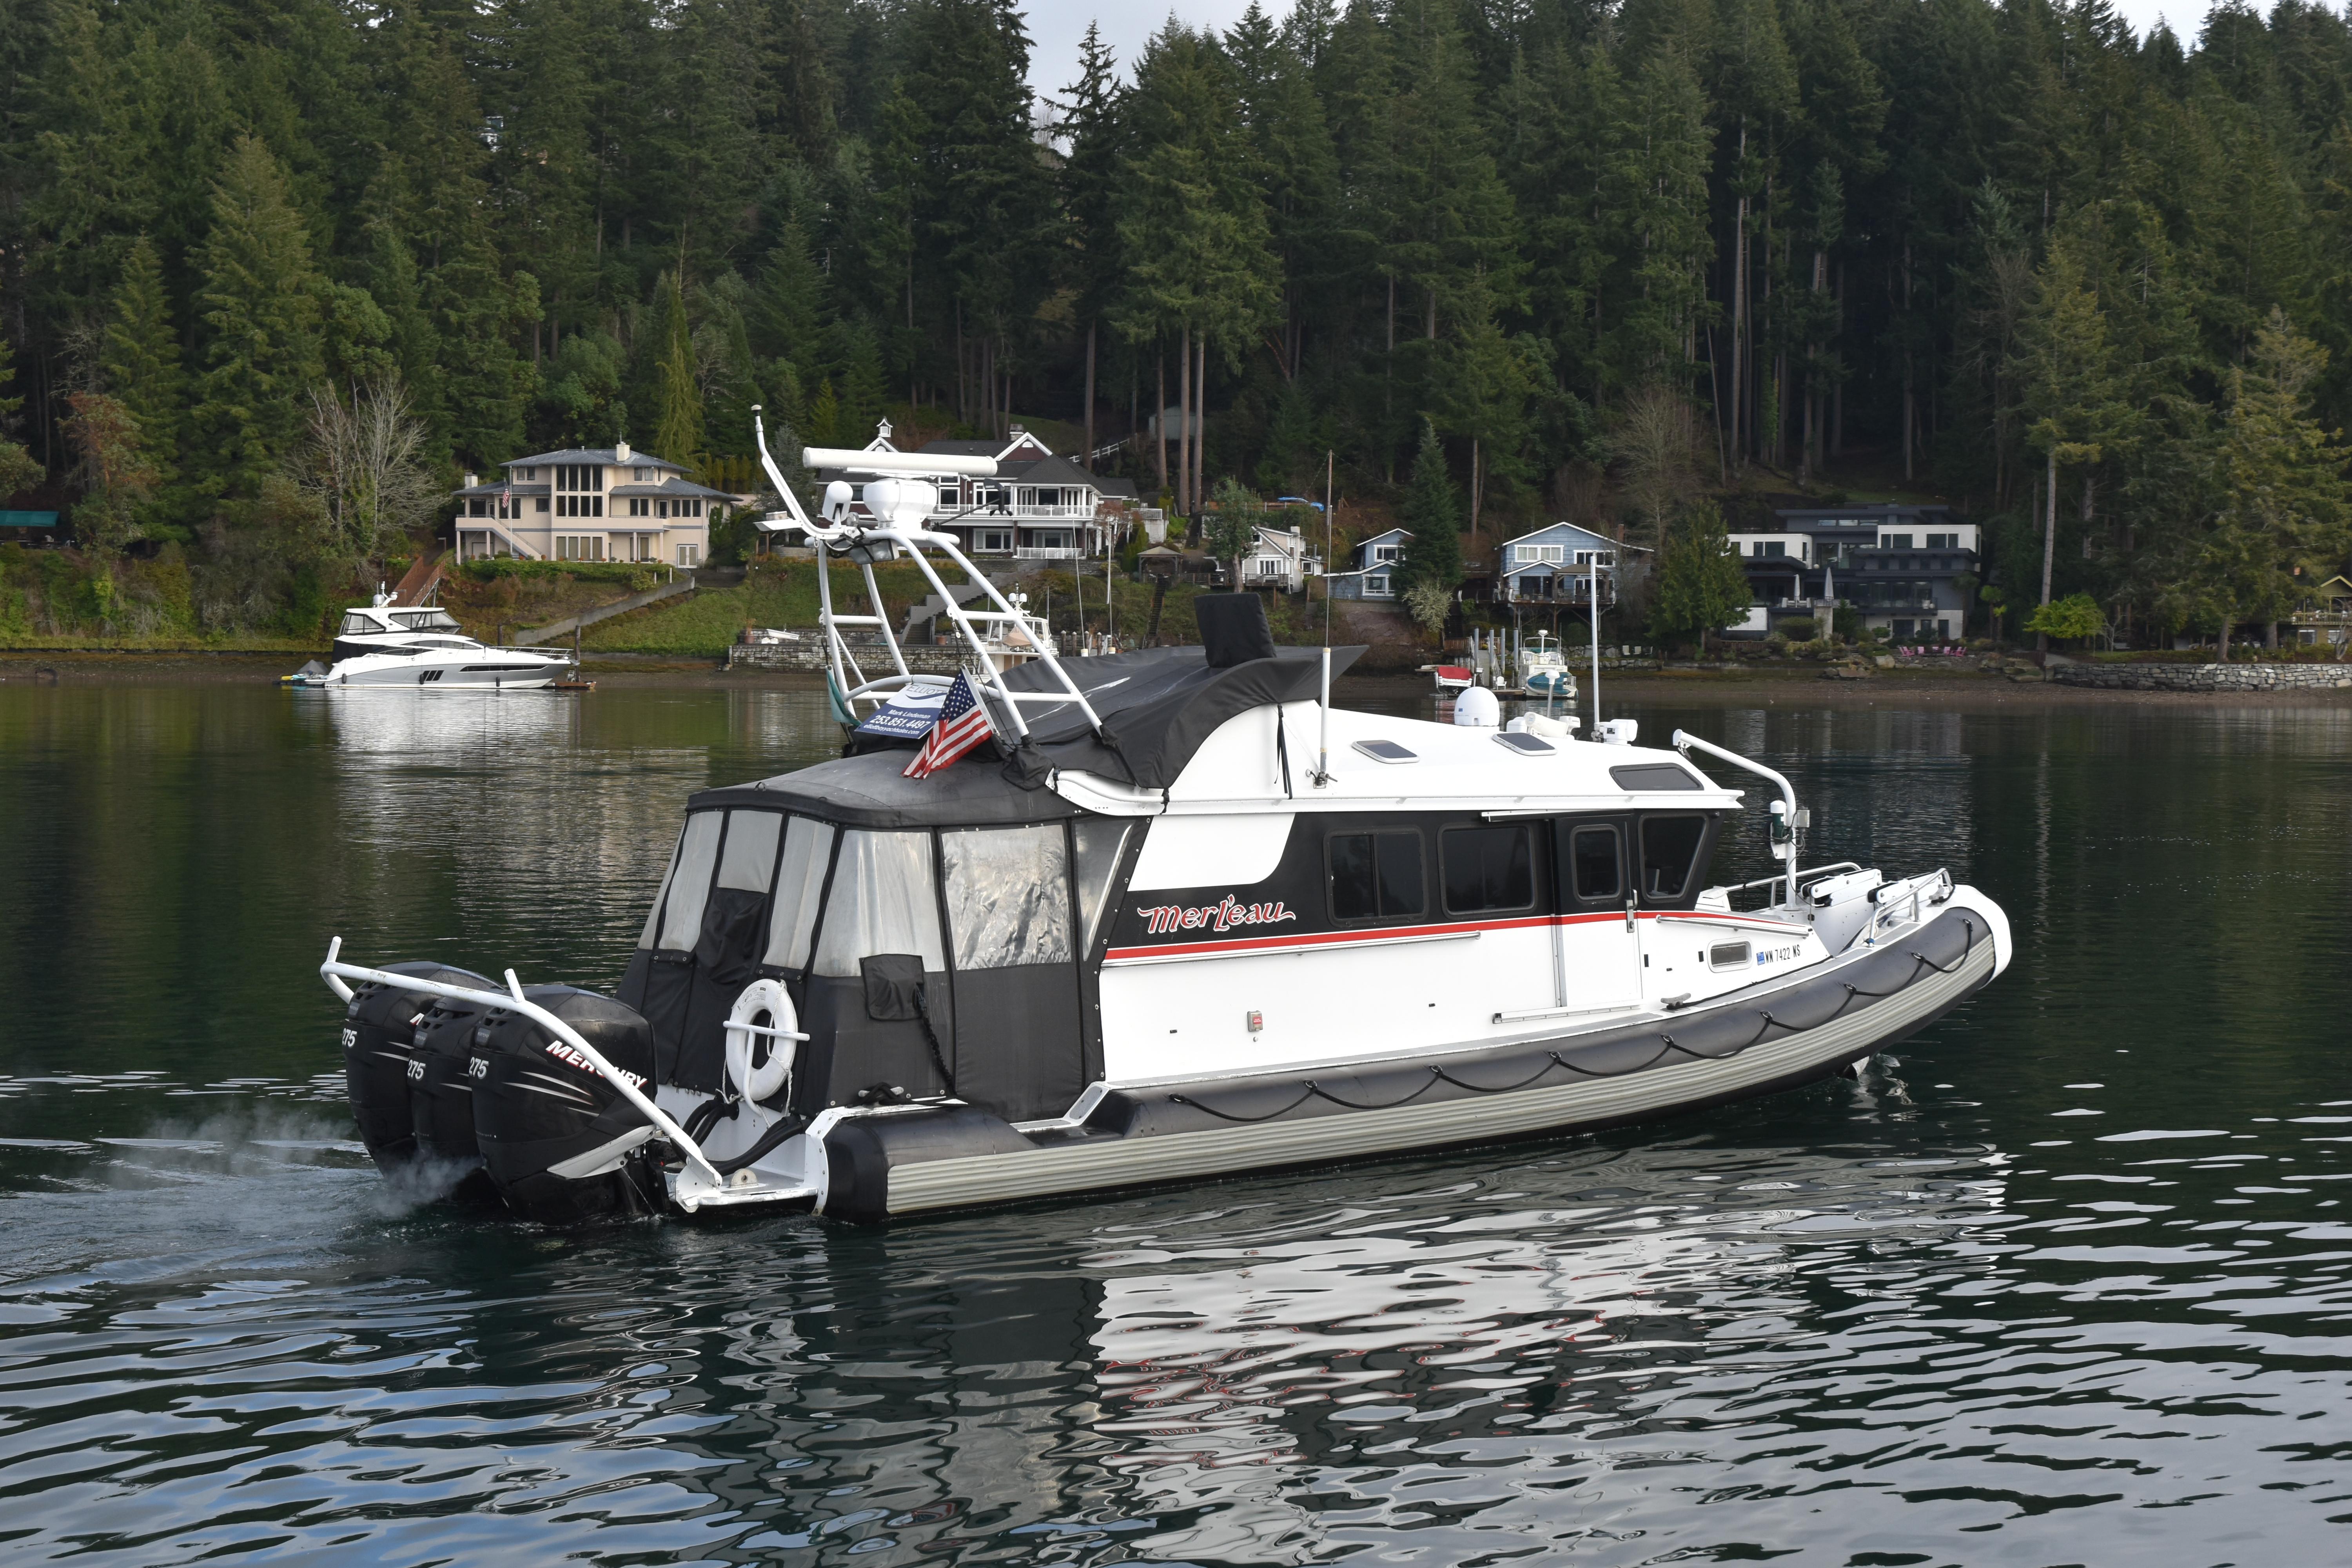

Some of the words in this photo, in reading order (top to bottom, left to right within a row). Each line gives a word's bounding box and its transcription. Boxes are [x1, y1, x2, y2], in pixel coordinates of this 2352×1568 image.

[863, 724, 920, 735] elliottbayyachtsales.com
[869, 715, 931, 729] 253.851.4497
[1765, 950, 1773, 963] WN
[1775, 947, 1791, 962] 7422
[1793, 944, 1800, 958] NS
[342, 1027, 358, 1047] 275
[407, 1059, 426, 1080] 275
[469, 1057, 489, 1078] 275
